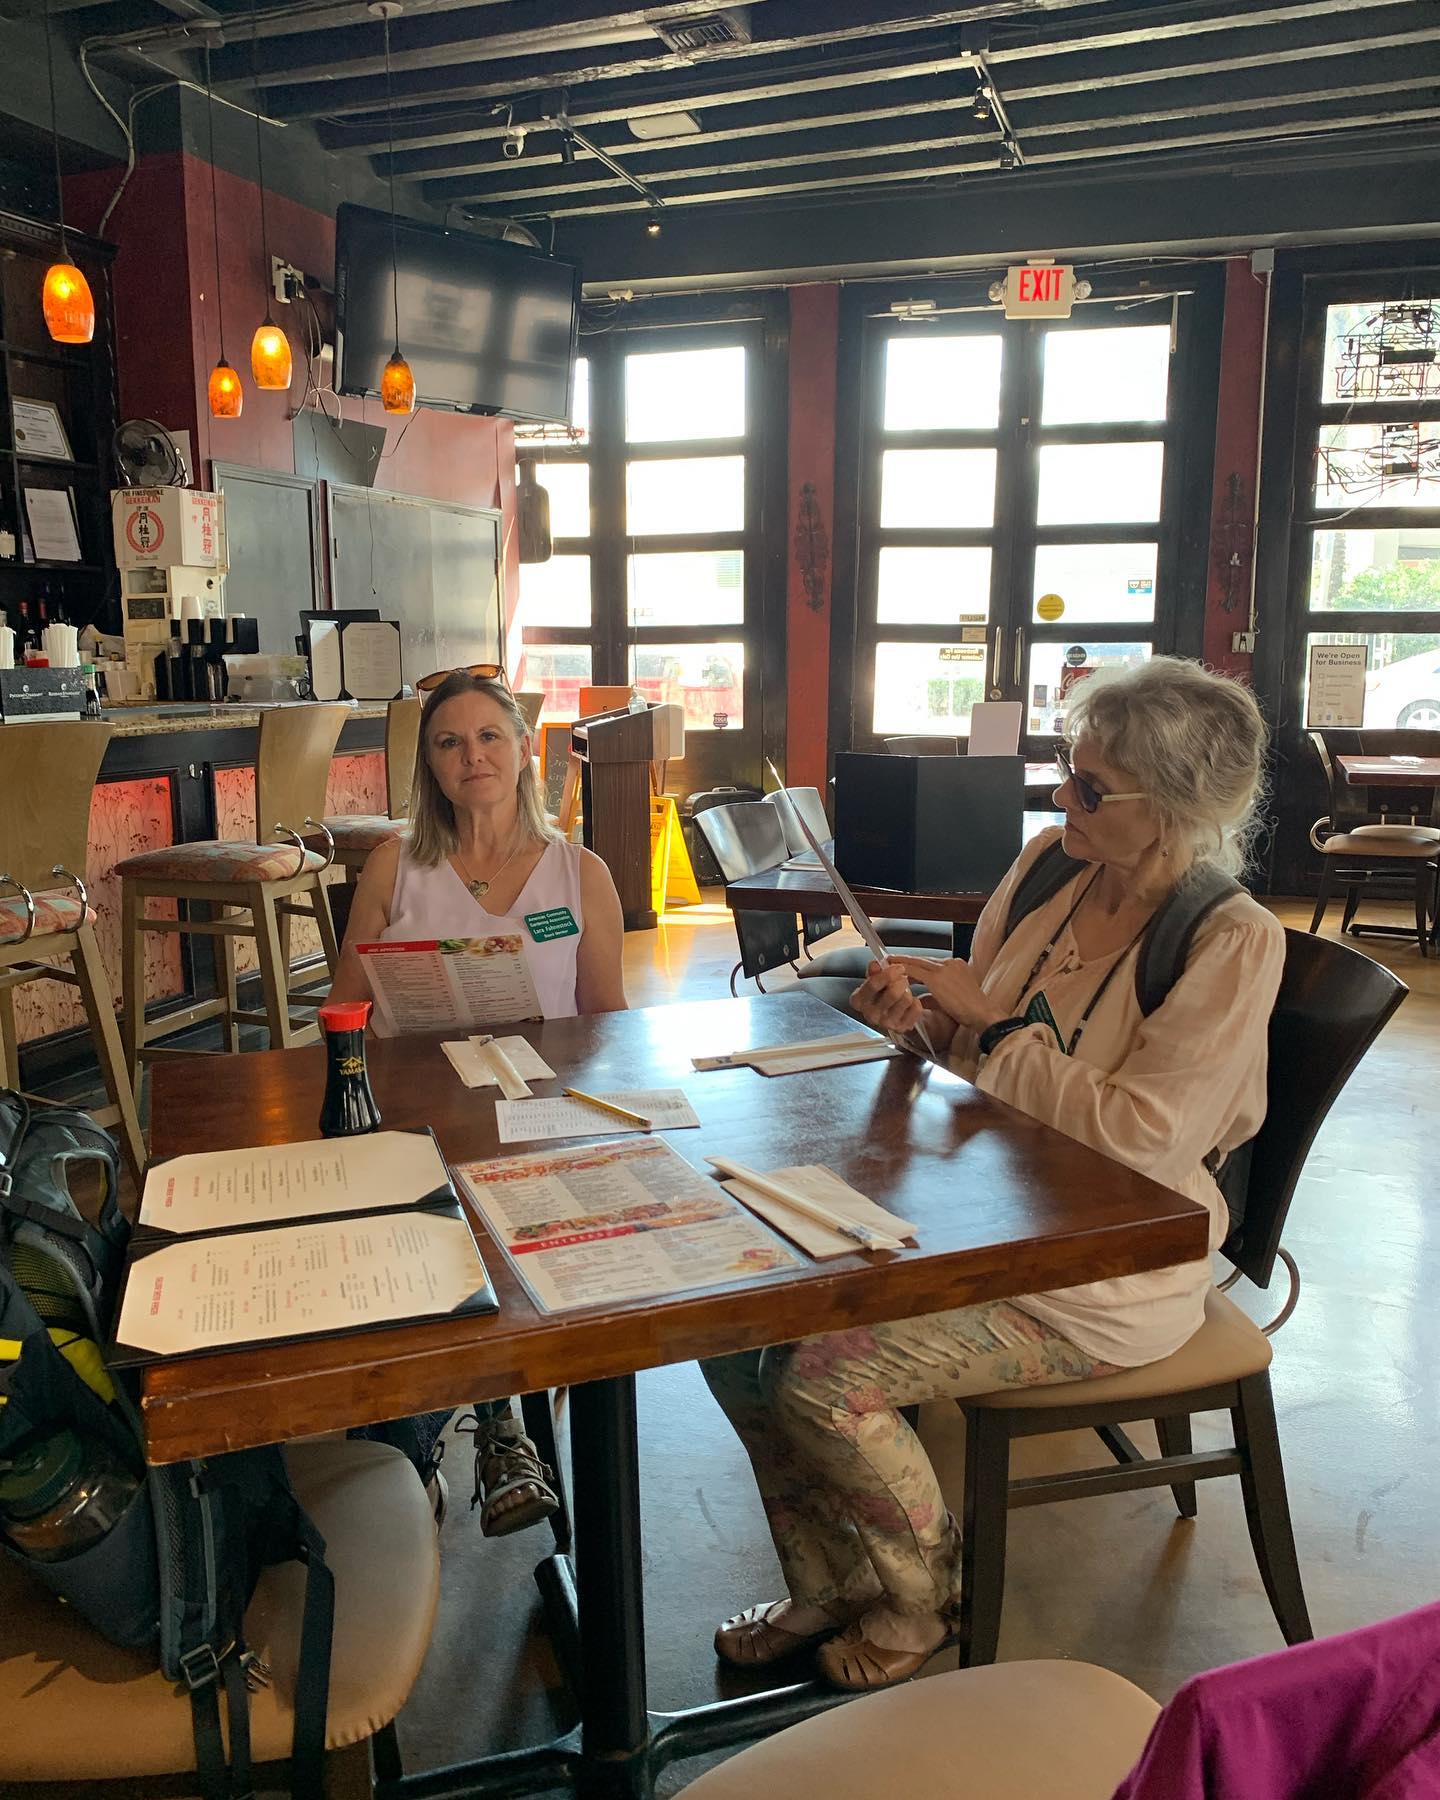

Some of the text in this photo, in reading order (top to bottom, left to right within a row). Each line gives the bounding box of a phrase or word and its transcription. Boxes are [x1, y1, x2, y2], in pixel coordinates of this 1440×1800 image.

[1019, 269, 1064, 302] EXIT
[138, 512, 150, 548] 月桂冠
